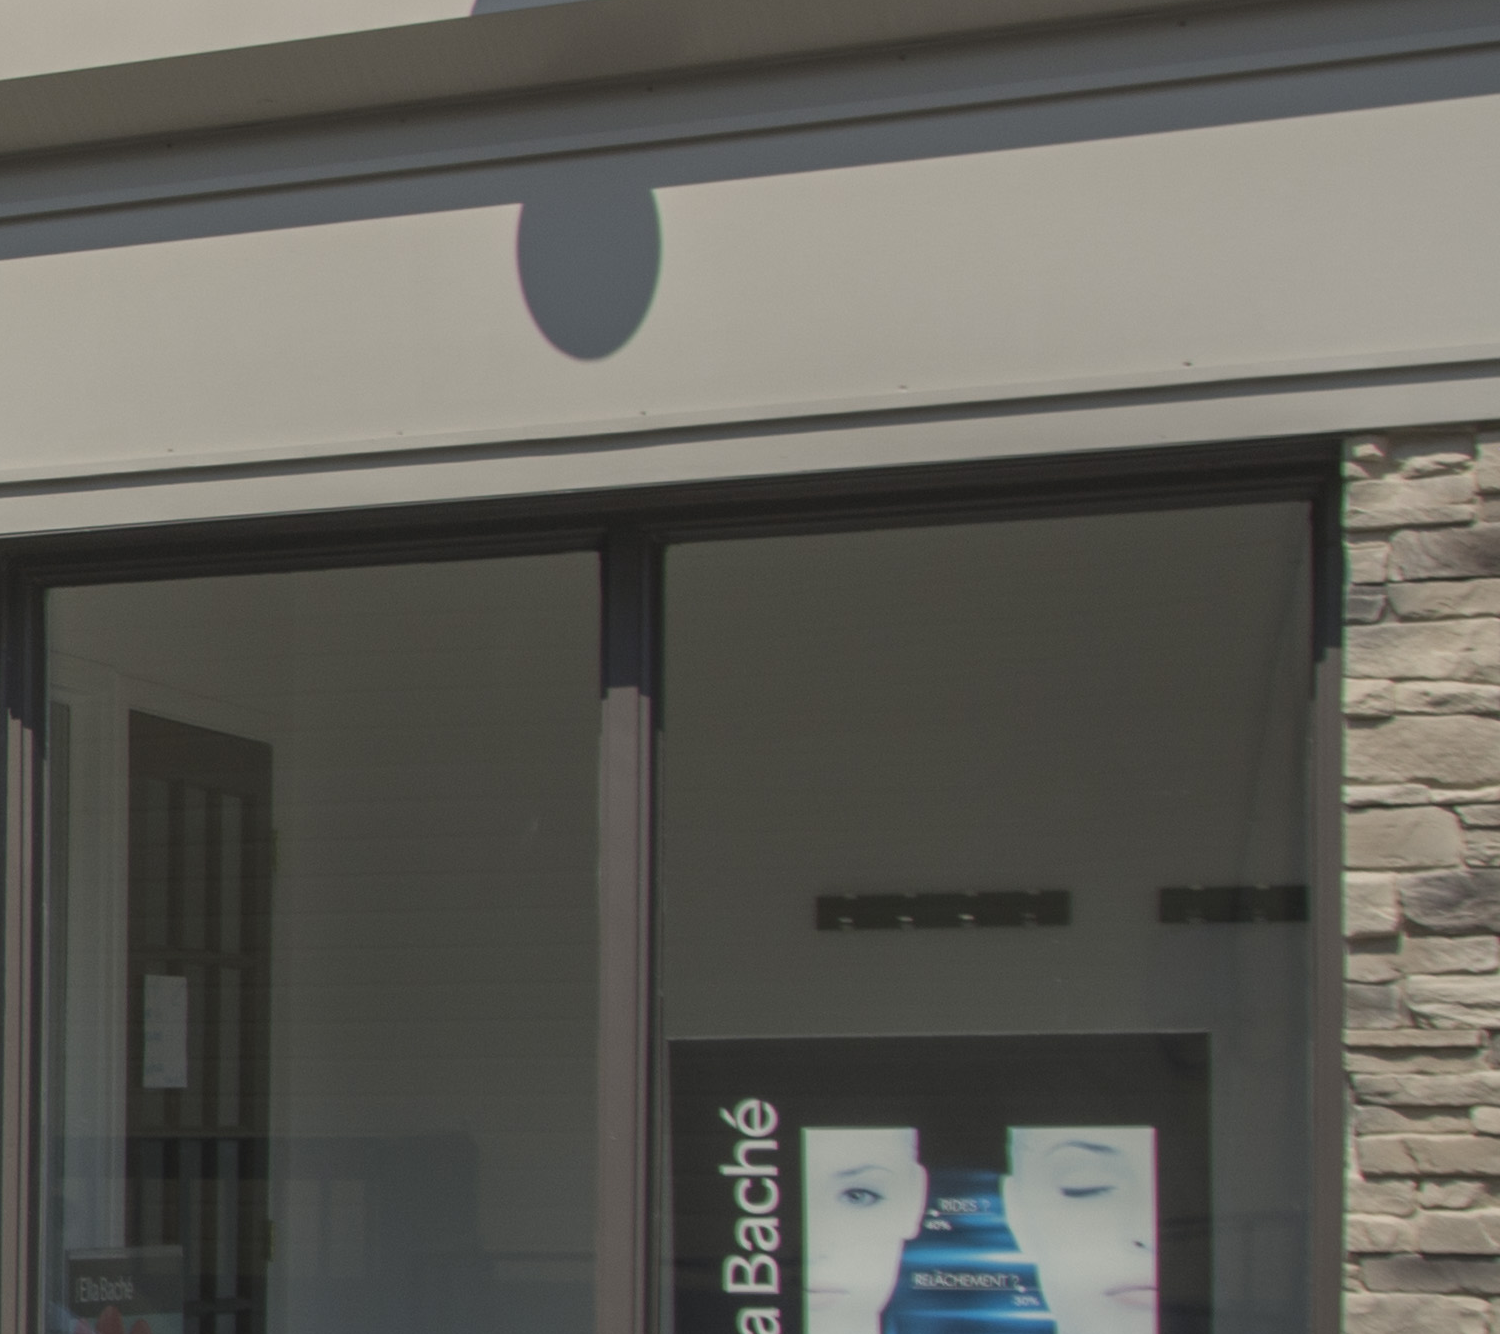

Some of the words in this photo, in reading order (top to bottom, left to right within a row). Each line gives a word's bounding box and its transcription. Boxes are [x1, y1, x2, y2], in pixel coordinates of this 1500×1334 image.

[718, 1098, 781, 1294] Baché
[940, 1198, 978, 1212] RIDES
[913, 1269, 1008, 1287] RELÂCHEMENT
